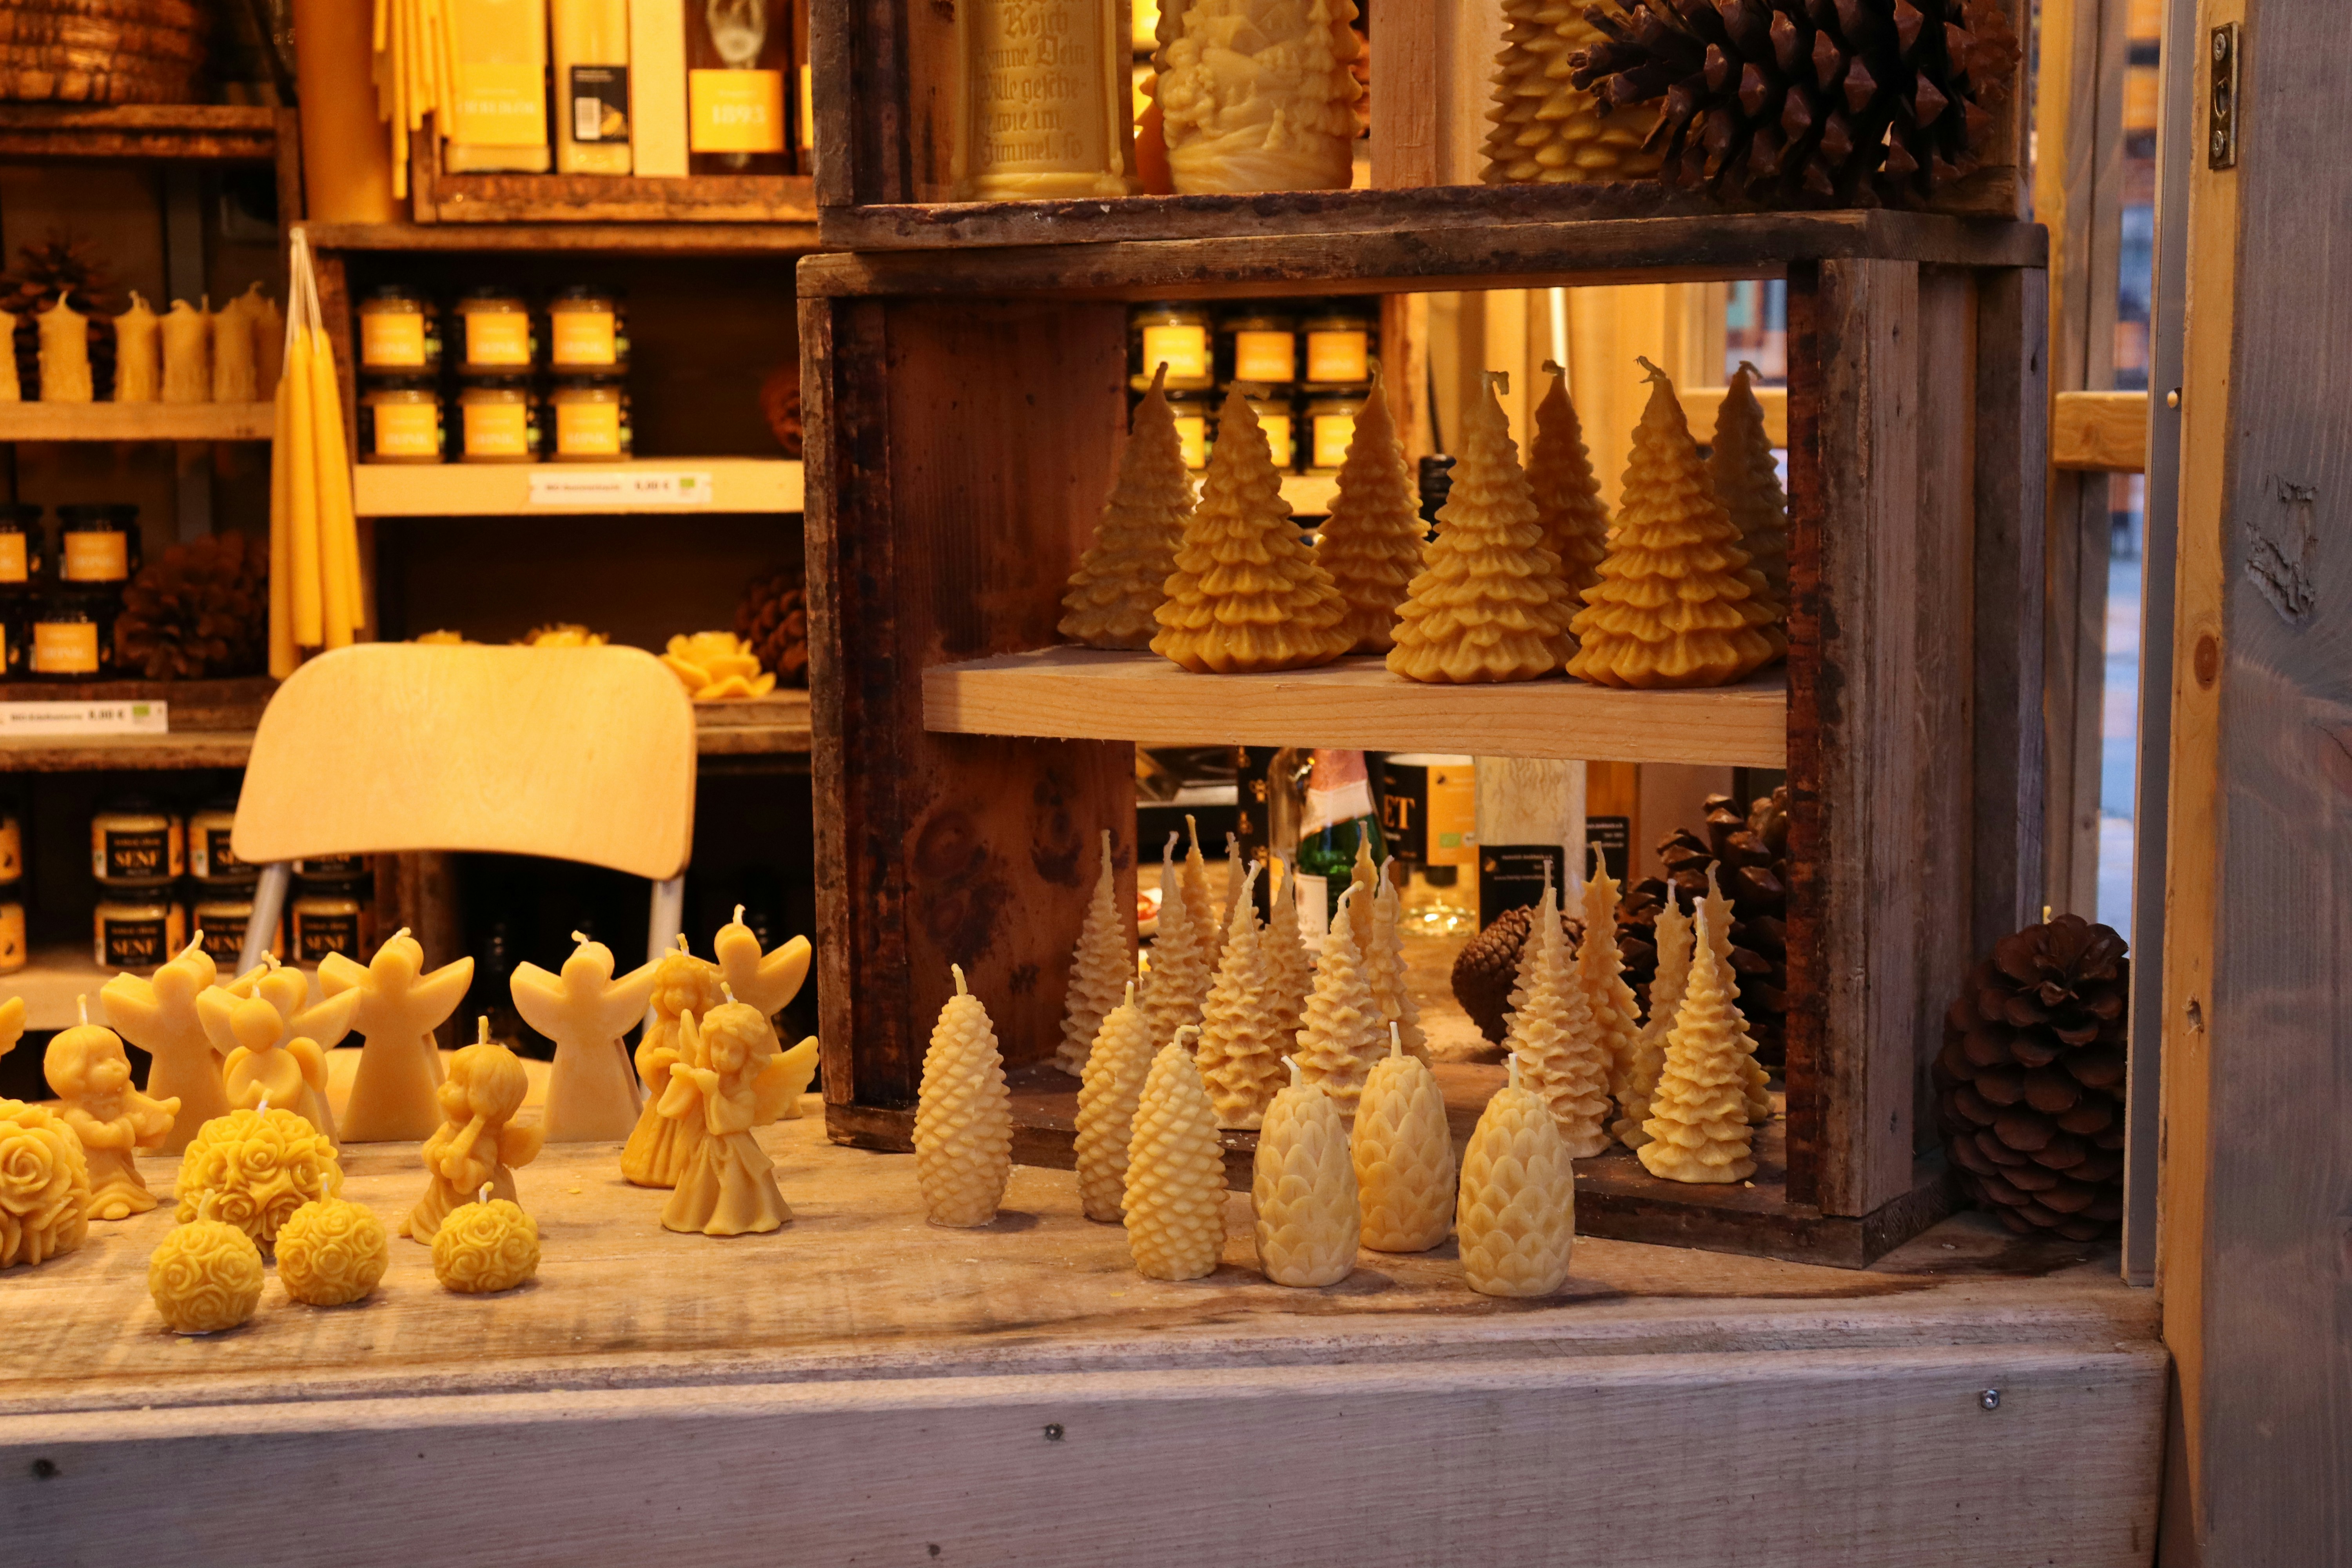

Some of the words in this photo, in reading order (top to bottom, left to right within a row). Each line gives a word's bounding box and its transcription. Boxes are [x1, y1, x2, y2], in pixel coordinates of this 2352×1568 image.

[1035, 34, 1086, 67] Dein
[712, 103, 766, 125] 1893
[1383, 794, 1416, 830] ET
[216, 849, 238, 866] SE
